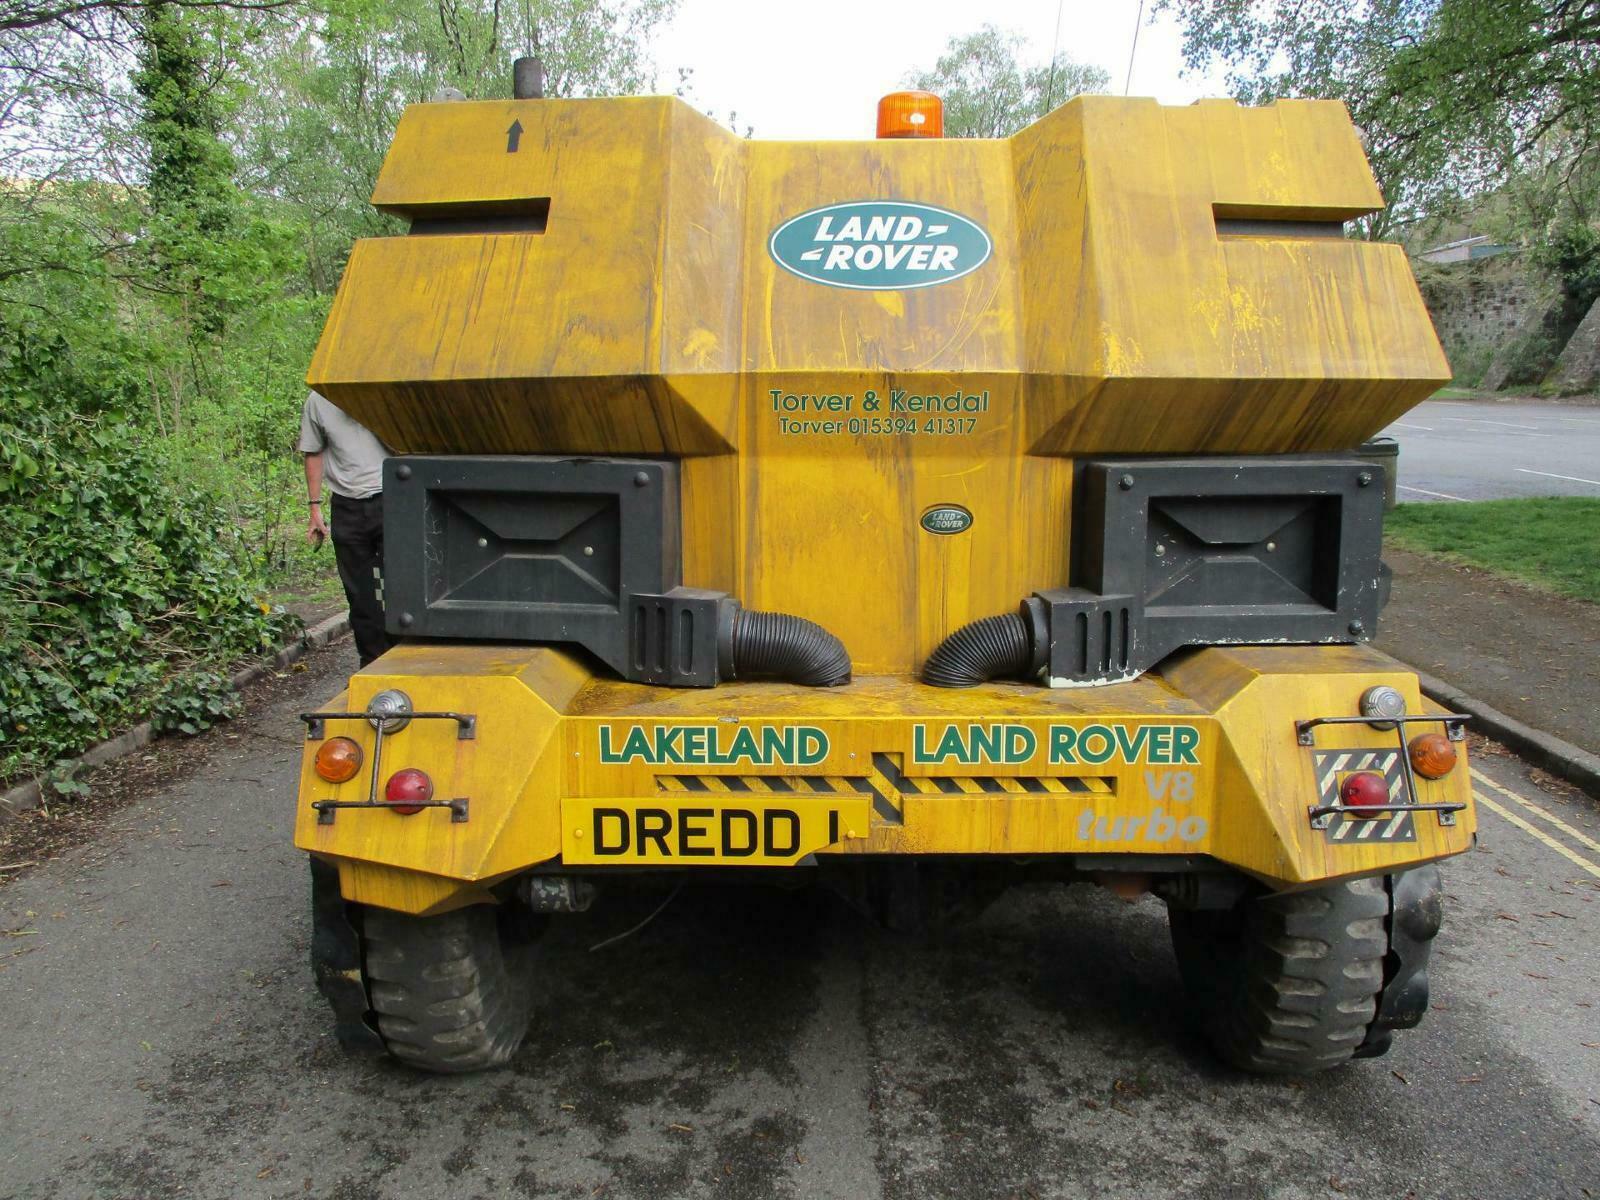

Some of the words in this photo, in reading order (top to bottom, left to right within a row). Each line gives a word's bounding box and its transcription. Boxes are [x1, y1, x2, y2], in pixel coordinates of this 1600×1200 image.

[813, 216, 923, 241] LAND
[823, 244, 959, 271] ROVER
[769, 389, 854, 413] Torver
[862, 390, 881, 412] &
[889, 389, 990, 413] Kendal
[779, 417, 843, 436] Torver
[848, 417, 917, 436] 015394
[923, 418, 978, 436] 41317
[932, 513, 956, 521] LAND
[934, 520, 964, 528] ROVER
[598, 725, 831, 766] LAKELAND
[912, 724, 1038, 765] LAND
[1048, 724, 1202, 765] ROVER
[1143, 771, 1195, 801] V8
[592, 807, 801, 858] DREDD
[1075, 807, 1209, 843] turbo
